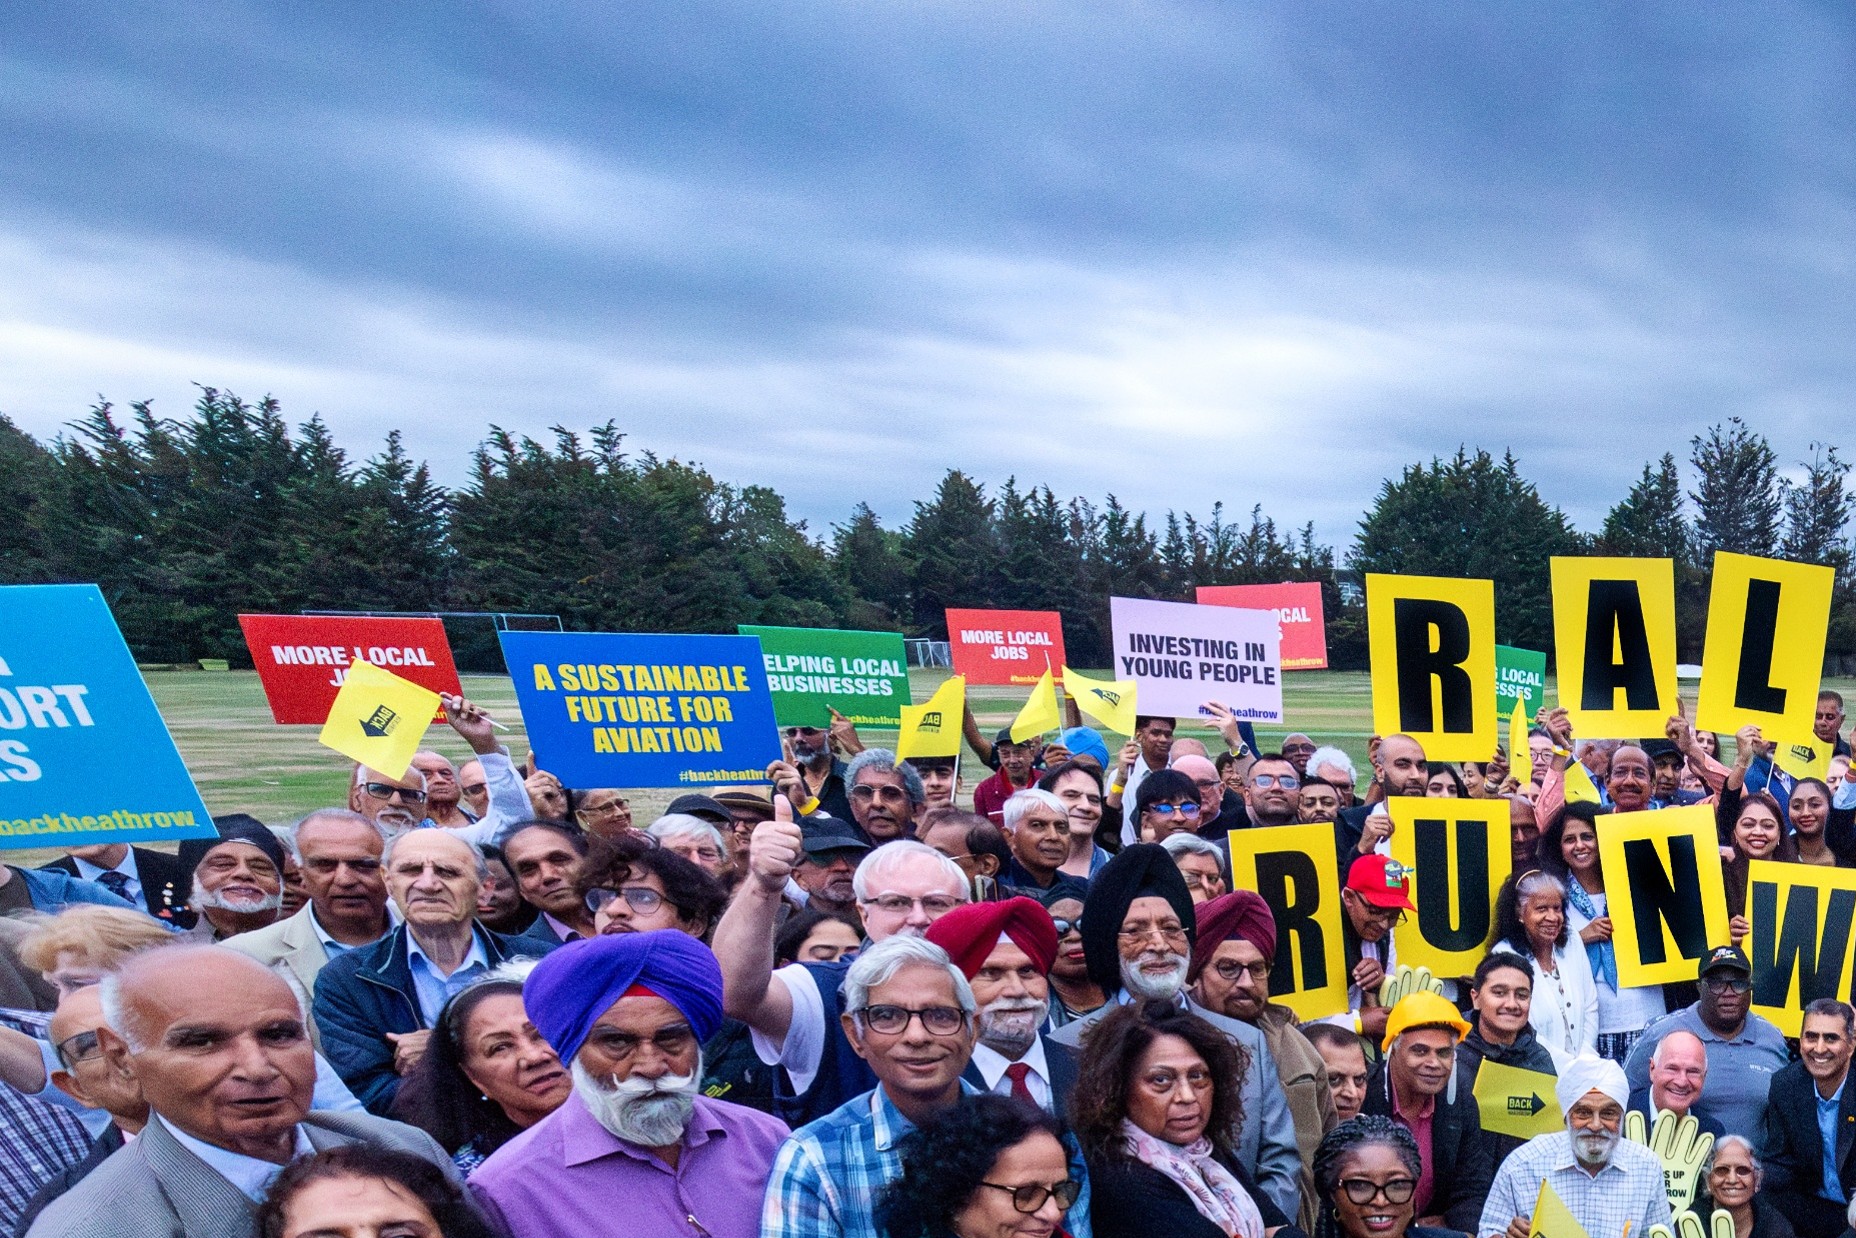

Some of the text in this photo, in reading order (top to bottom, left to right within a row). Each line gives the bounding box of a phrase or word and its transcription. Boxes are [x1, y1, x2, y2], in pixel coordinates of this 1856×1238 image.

[960, 630, 1053, 645] MORE LOCAL
[1129, 633, 1266, 662] INVESTING IN
[271, 645, 435, 666] MORE LOCAL
[990, 646, 1029, 660] JOBS
[762, 653, 906, 677] ELPING LOCAL
[1121, 656, 1276, 686] YOUNG PEOPLE
[533, 664, 751, 692] A SUSTAINABLE
[767, 673, 894, 696] BUSINESSES
[1501, 667, 1543, 687] LOCAL
[565, 696, 733, 723] FUTURE FOR
[593, 727, 723, 753] AVIATION
[1508, 1098, 1533, 1109] BACK
[1673, 1170, 1685, 1179] UP
